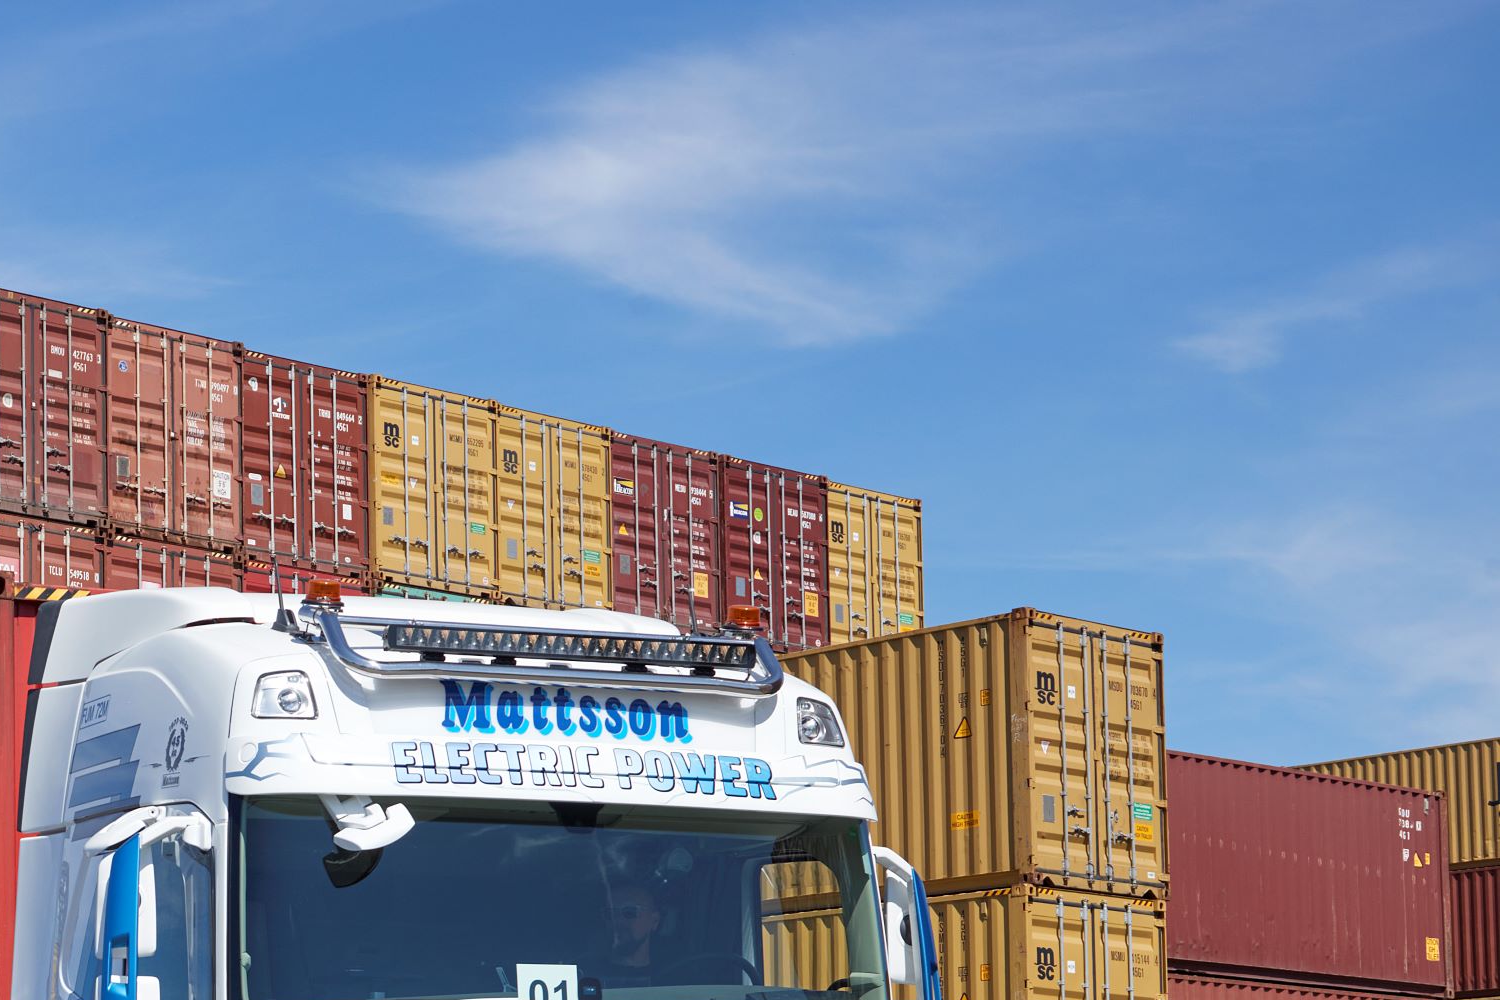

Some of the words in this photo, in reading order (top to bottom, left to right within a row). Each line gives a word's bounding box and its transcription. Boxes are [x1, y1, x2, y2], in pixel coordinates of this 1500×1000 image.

[72, 350, 94, 362] 427763
[73, 362, 87, 373] 45G1
[48, 565, 62, 576] TCLU
[70, 570, 90, 580] 549518
[1109, 681, 1123, 692] MSDU
[440, 678, 694, 743] Mattsson
[172, 735, 181, 747] 45
[391, 740, 607, 790] ELECTRIC
[616, 747, 778, 802] POWER
[1111, 951, 1125, 962] MSMU
